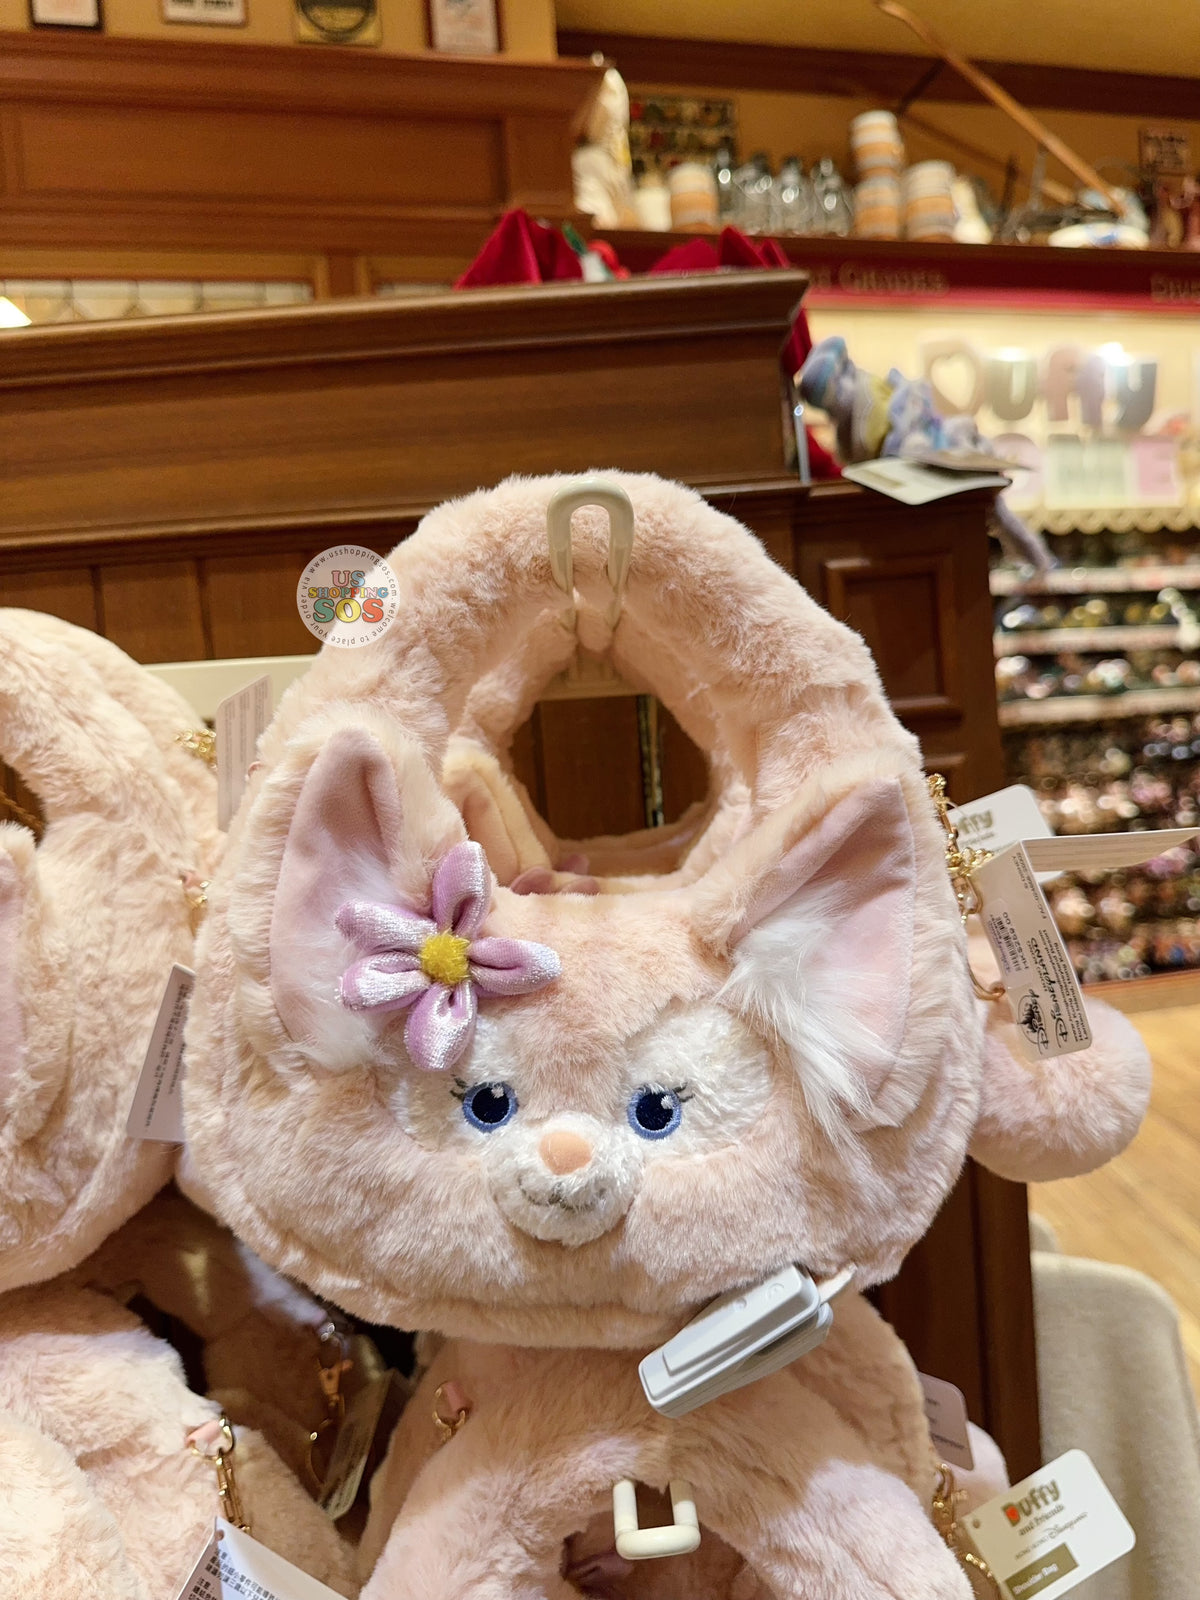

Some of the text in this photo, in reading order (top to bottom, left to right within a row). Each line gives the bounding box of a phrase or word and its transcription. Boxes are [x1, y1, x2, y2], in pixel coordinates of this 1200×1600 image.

[1042, 928, 1084, 1041] Hong Kong Disneyland Resort
[1068, 985, 1080, 1011] Island,
[1028, 988, 1049, 1055] Disney
[1077, 1012, 1088, 1039] Lantau
[1002, 1480, 1060, 1527] Duffy
